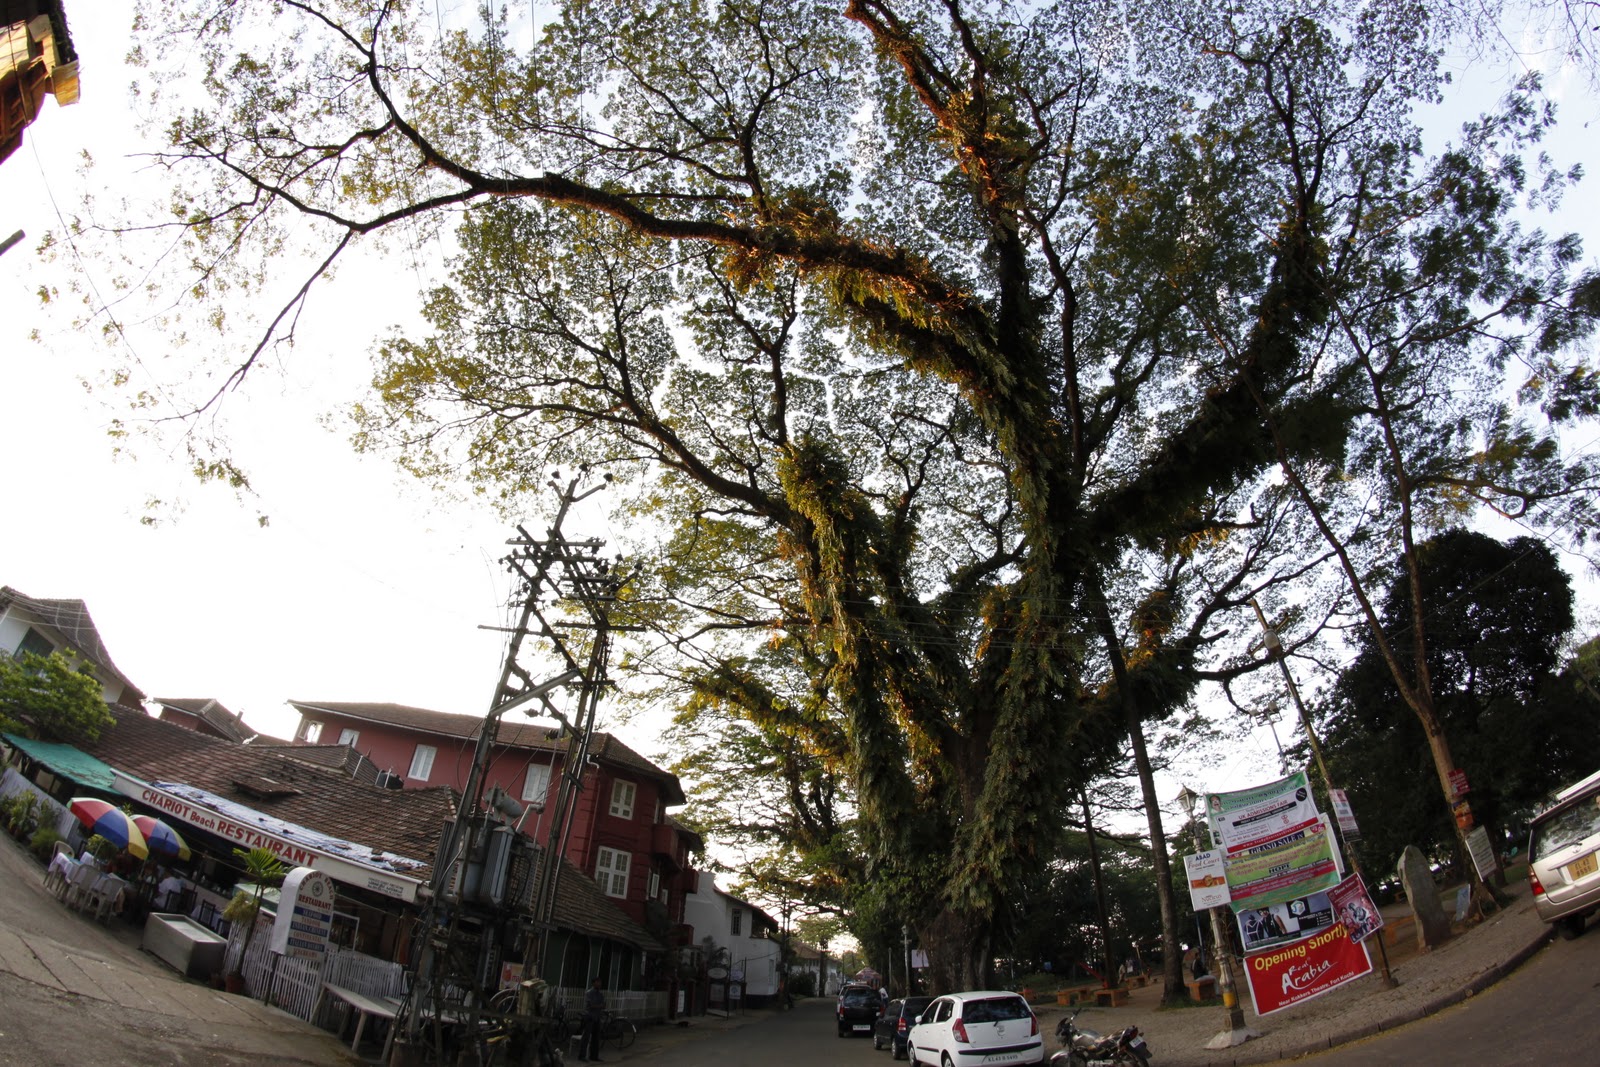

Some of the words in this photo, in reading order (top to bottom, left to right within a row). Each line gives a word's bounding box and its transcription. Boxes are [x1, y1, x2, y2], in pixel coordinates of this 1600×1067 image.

[1247, 804, 1277, 817] ADMISSIONS
[1277, 799, 1288, 807] FAIR
[142, 789, 191, 818] CHARIOT
[190, 810, 215, 829] Beach
[217, 820, 319, 867] RESTAURANT
[1251, 842, 1277, 854] GRAND
[1278, 835, 1296, 847] SALE
[1188, 861, 1202, 869] Food
[1203, 857, 1220, 866] Court
[1195, 853, 1211, 861] ABAD
[300, 872, 322, 891] CHARIOT
[298, 894, 332, 911] RESTAURANT
[1254, 945, 1306, 971] Opening
[1308, 924, 1348, 950] Shortly
[1281, 960, 1332, 995] Arabia
[1288, 962, 1309, 976] Real
[1279, 998, 1290, 1007] Near
[1330, 977, 1340, 986] Fort
[1340, 971, 1355, 981] Kochi
